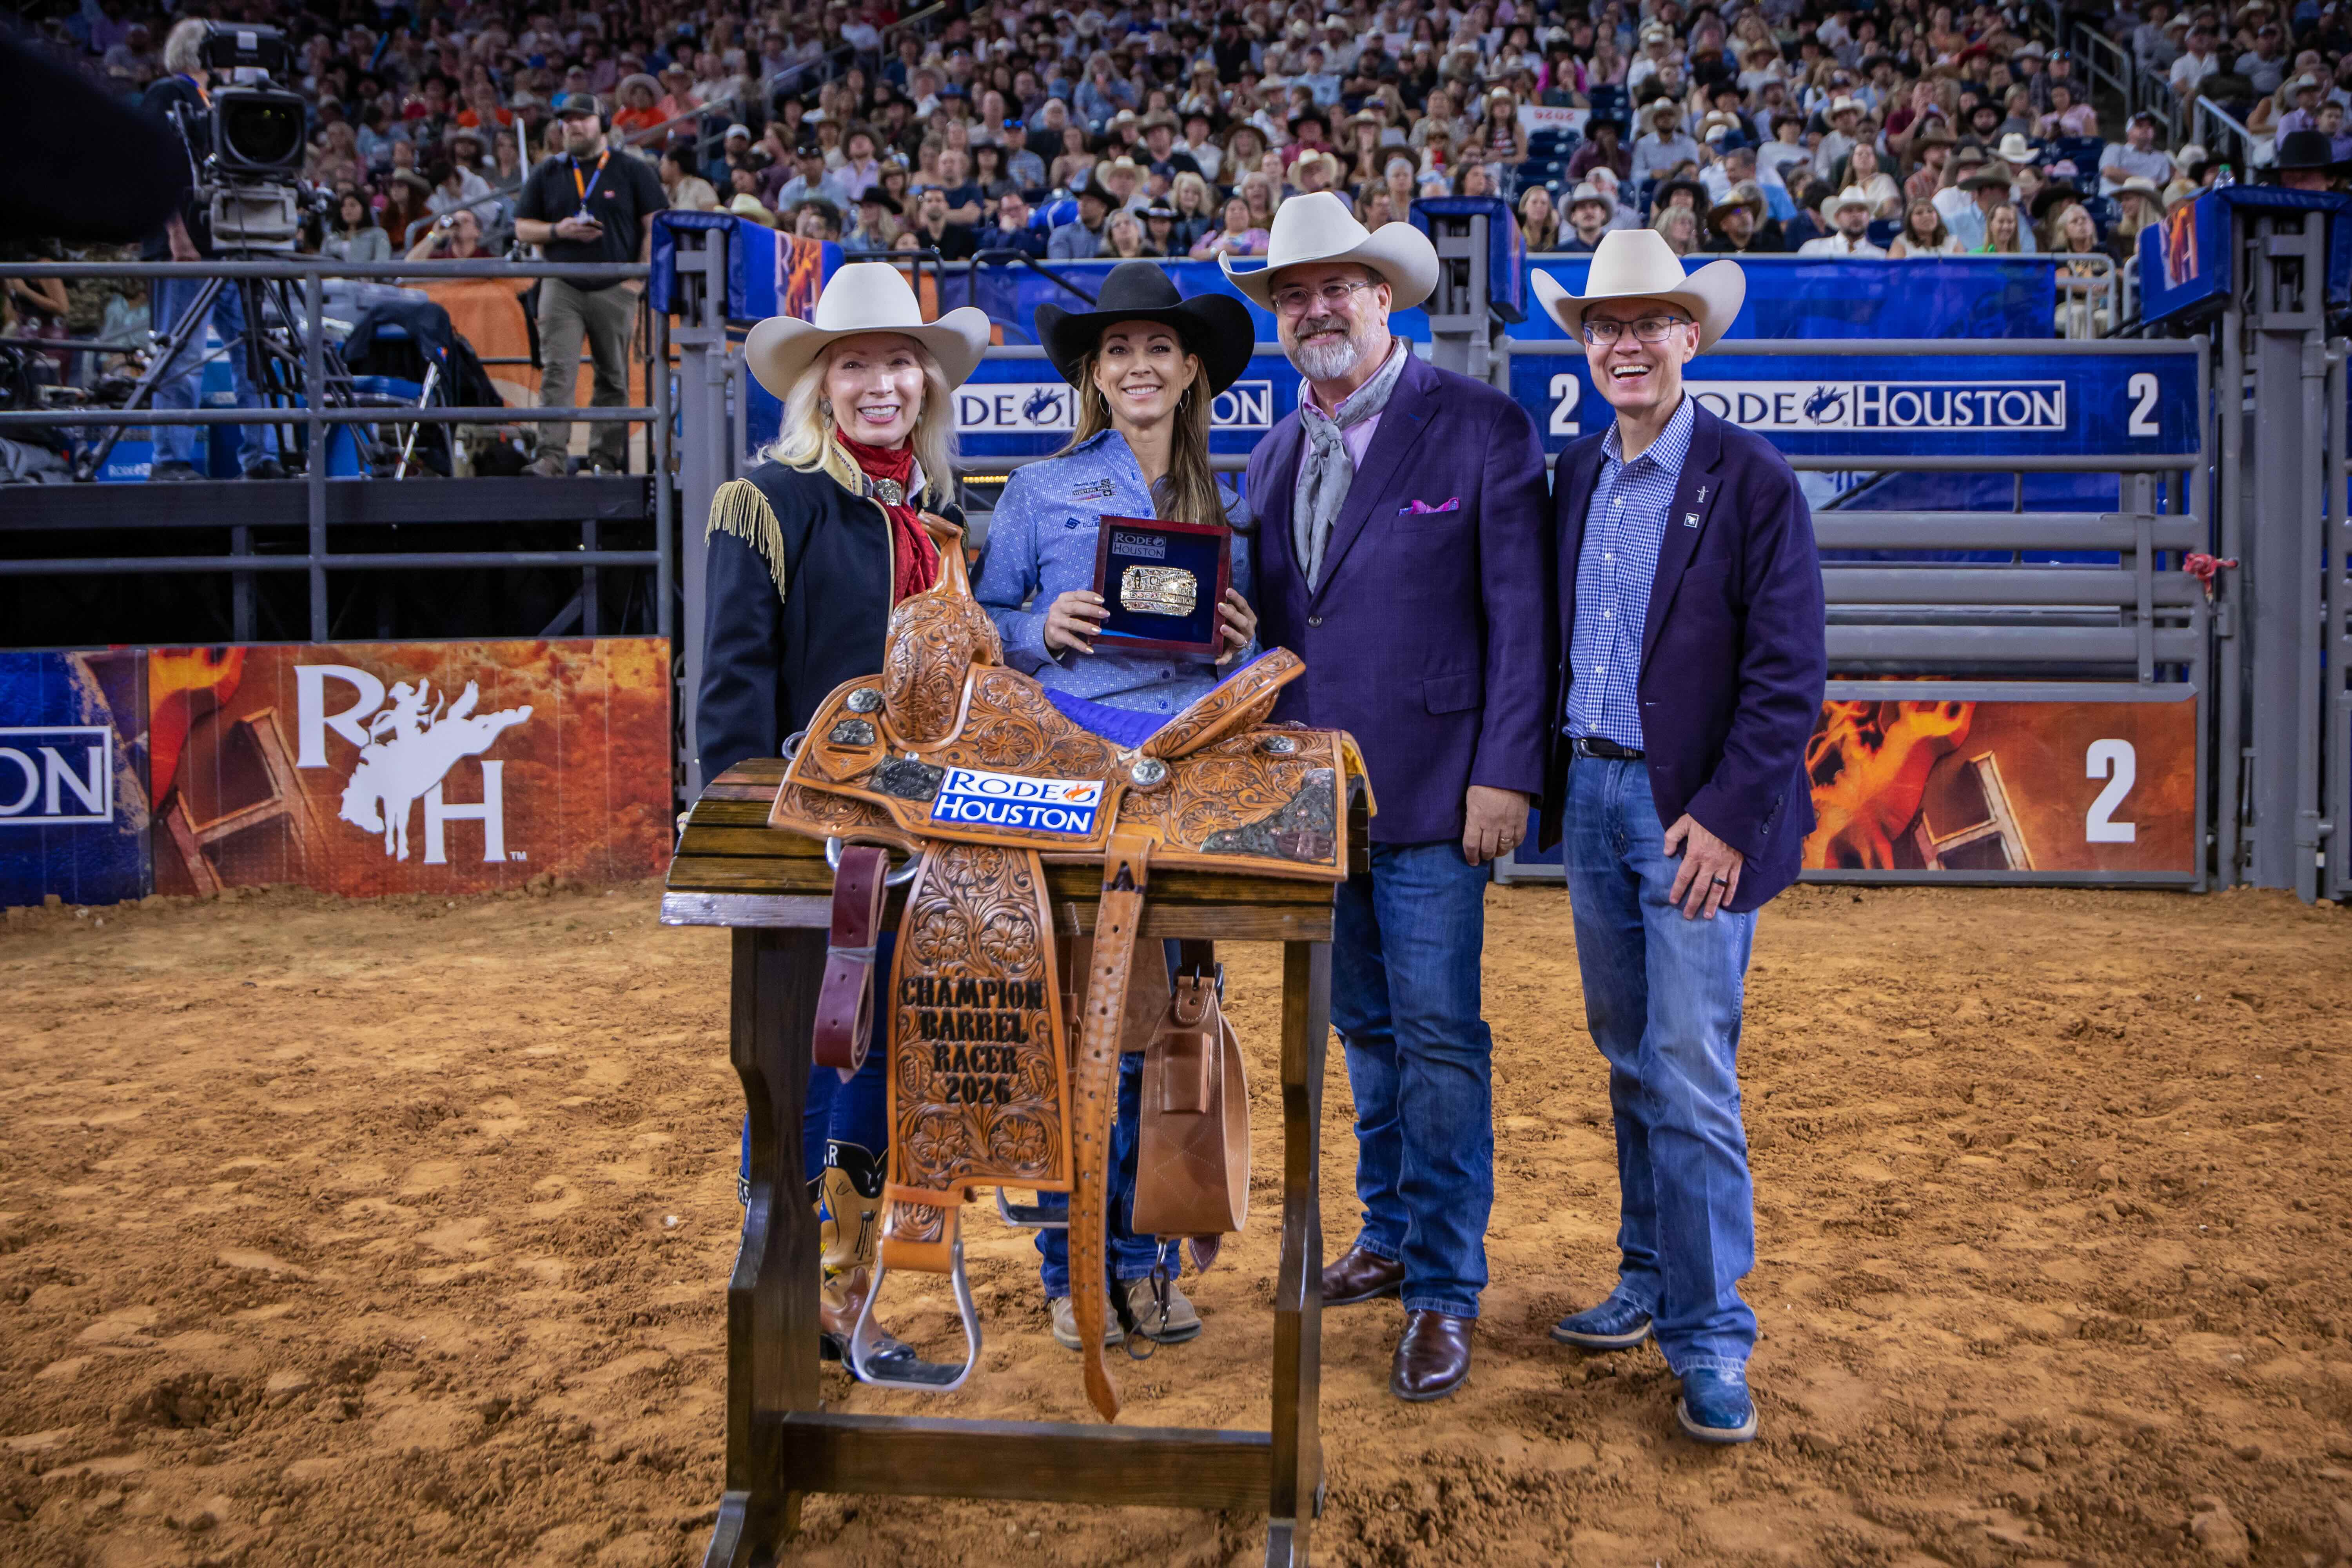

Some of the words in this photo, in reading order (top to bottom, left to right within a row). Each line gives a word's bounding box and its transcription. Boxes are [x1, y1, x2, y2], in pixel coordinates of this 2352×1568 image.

[960, 387, 1064, 426] DEO
[1549, 374, 1580, 436] 2
[1696, 386, 1848, 425] ODEO
[1856, 385, 2062, 426] HOUSTON
[2128, 373, 2159, 437] 2
[1114, 543, 1164, 557] HOUSTON
[1115, 533, 1164, 546] RODEO
[947, 771, 1099, 804] RODEO
[2086, 738, 2136, 842] 2
[933, 795, 1091, 831] HOUSTON
[902, 976, 1042, 1009] CHAMPION
[920, 1010, 1029, 1043] BARREL
[934, 1043, 1018, 1074] RACER
[945, 1076, 1011, 1104] 2026
